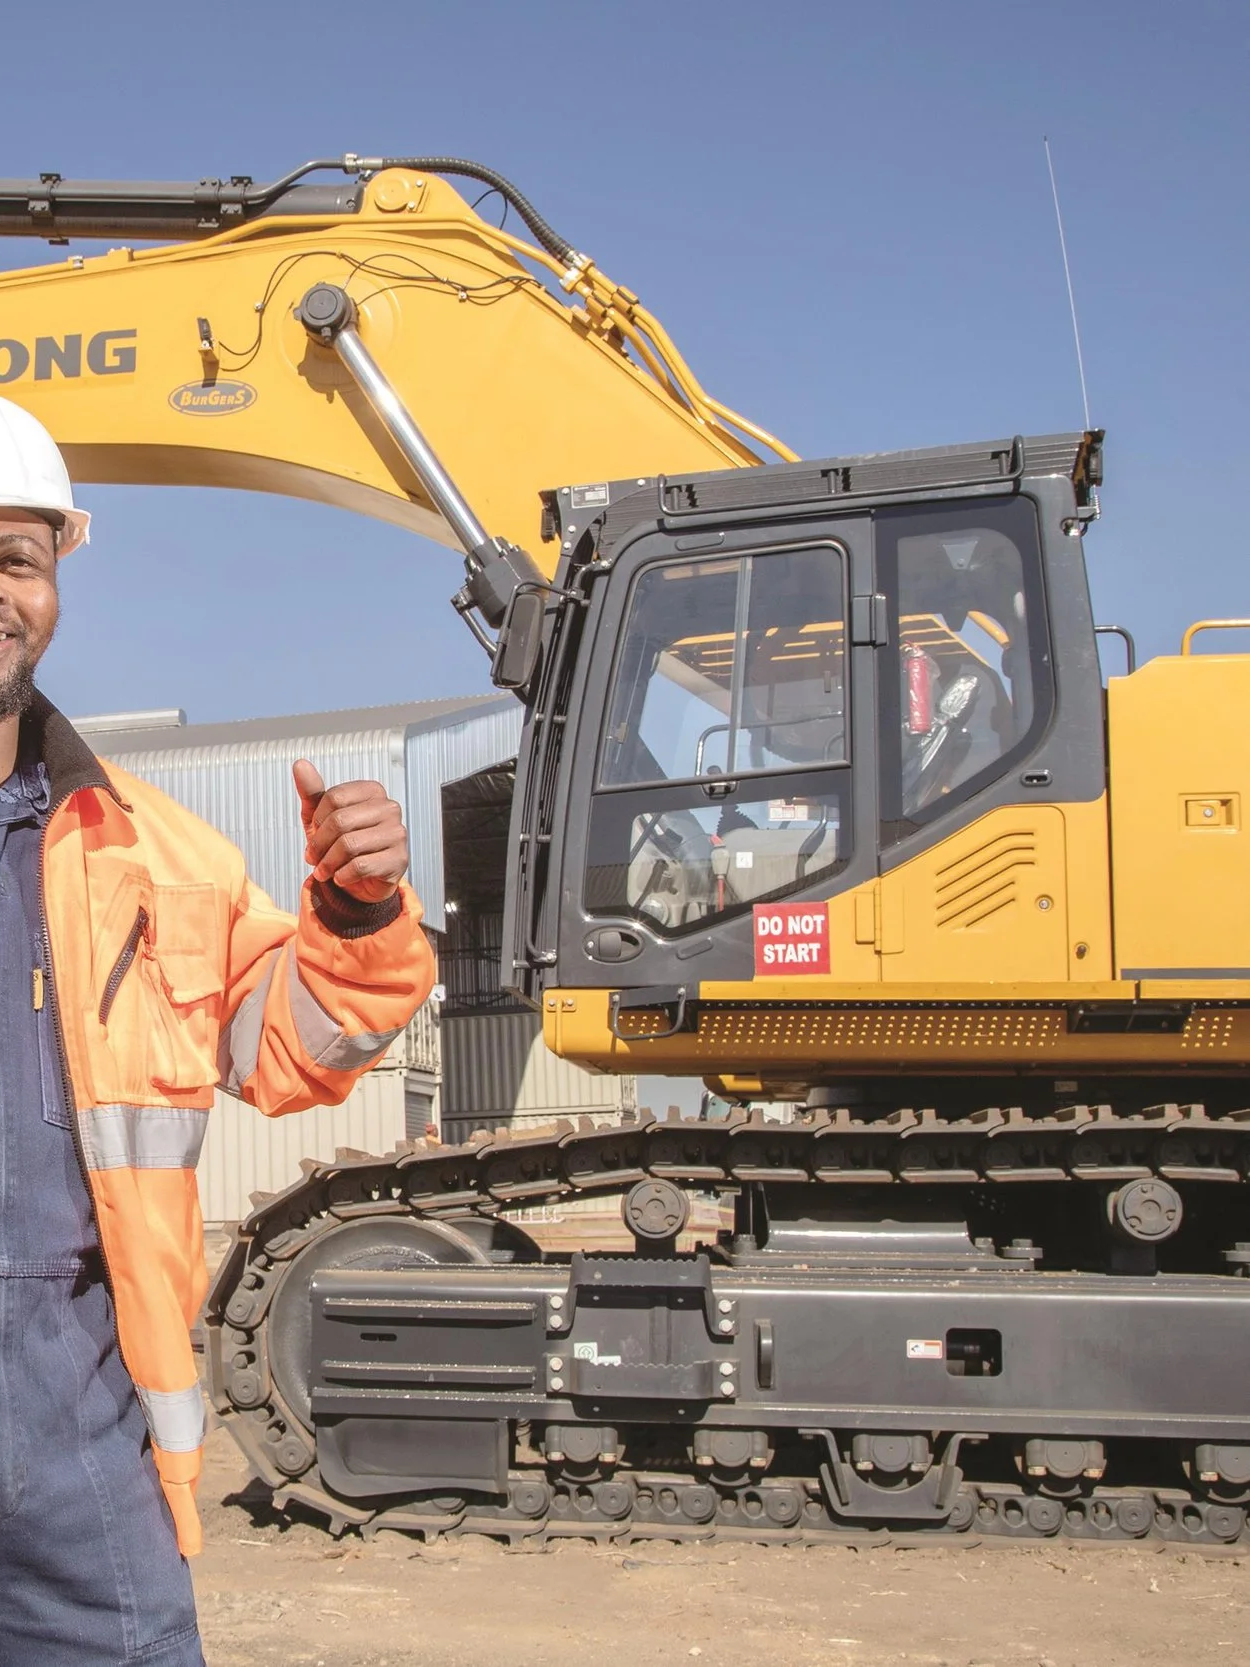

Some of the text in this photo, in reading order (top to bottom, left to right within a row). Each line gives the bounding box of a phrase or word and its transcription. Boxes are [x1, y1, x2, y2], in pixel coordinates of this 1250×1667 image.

[758, 915, 825, 936] DO NOT
[763, 943, 821, 963] START
